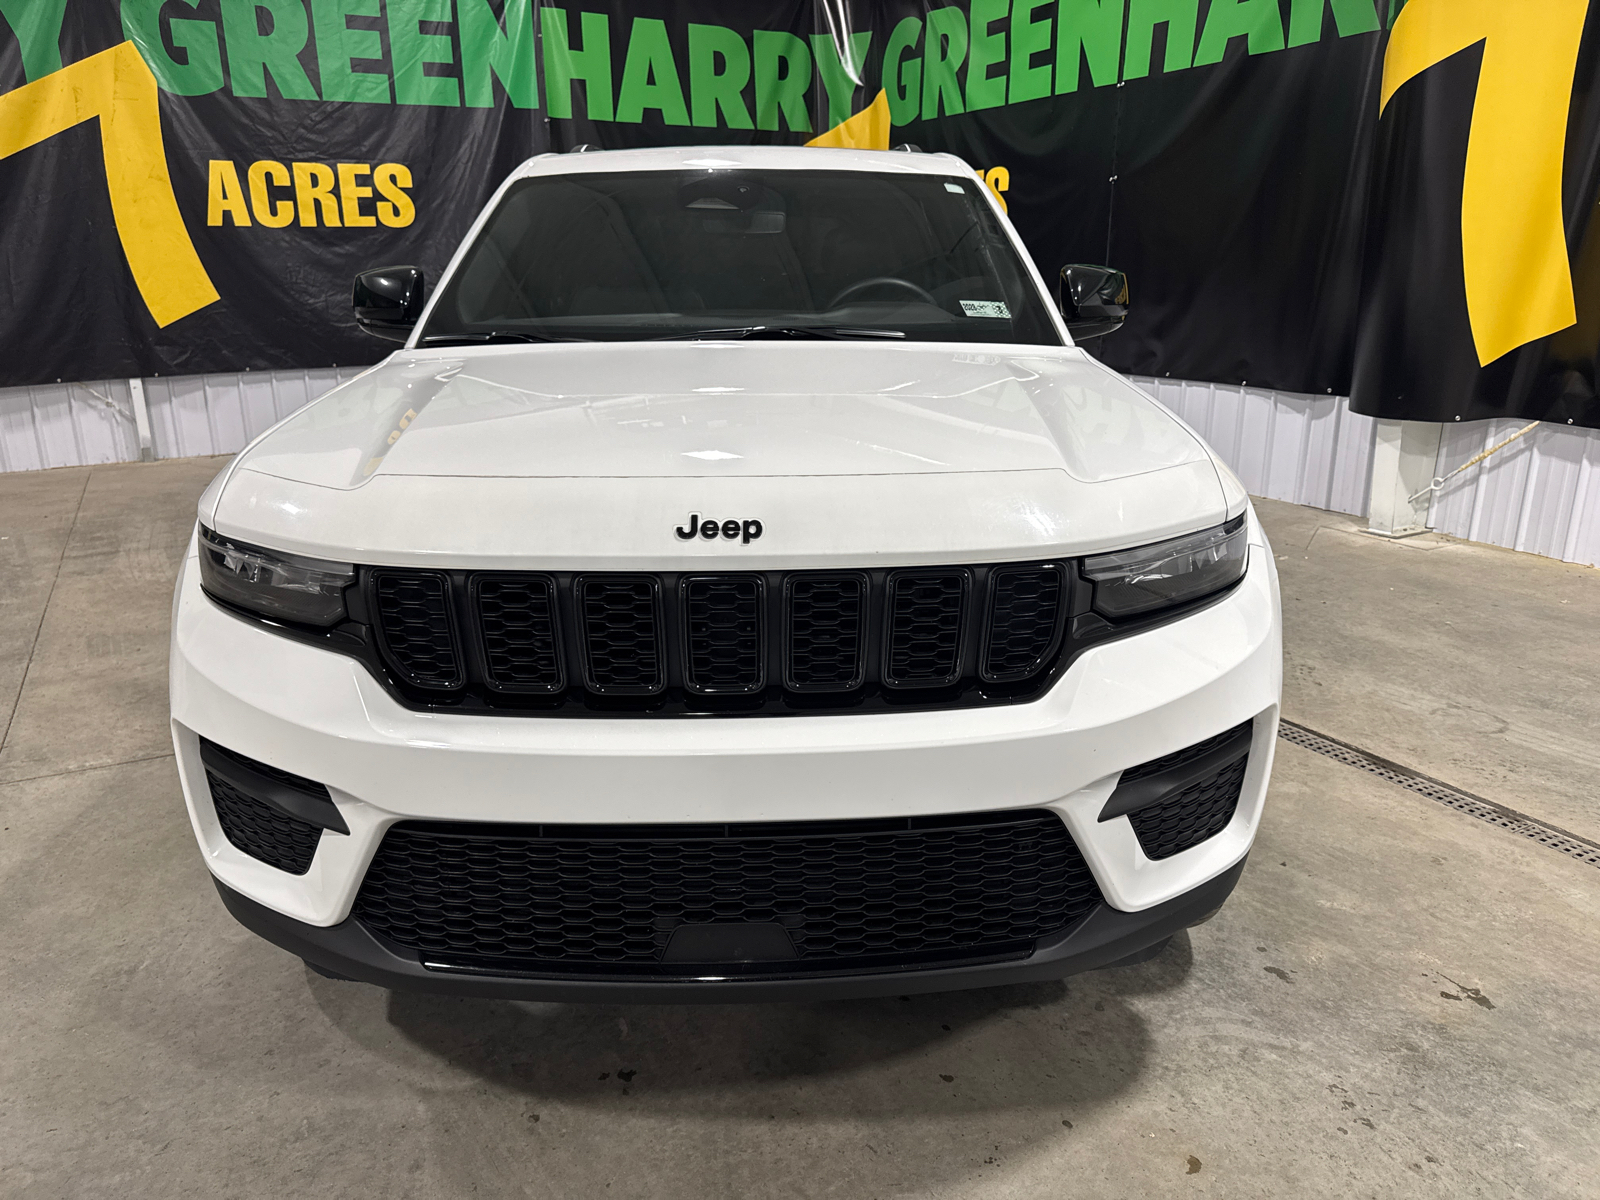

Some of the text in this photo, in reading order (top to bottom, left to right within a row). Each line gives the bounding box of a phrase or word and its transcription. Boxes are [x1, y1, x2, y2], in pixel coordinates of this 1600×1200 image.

[121, 0, 539, 109] GREEN
[540, 7, 873, 133] HARRY
[881, 0, 1124, 127] GREEN
[207, 160, 416, 229] ACRES
[674, 513, 764, 545] Jeep
